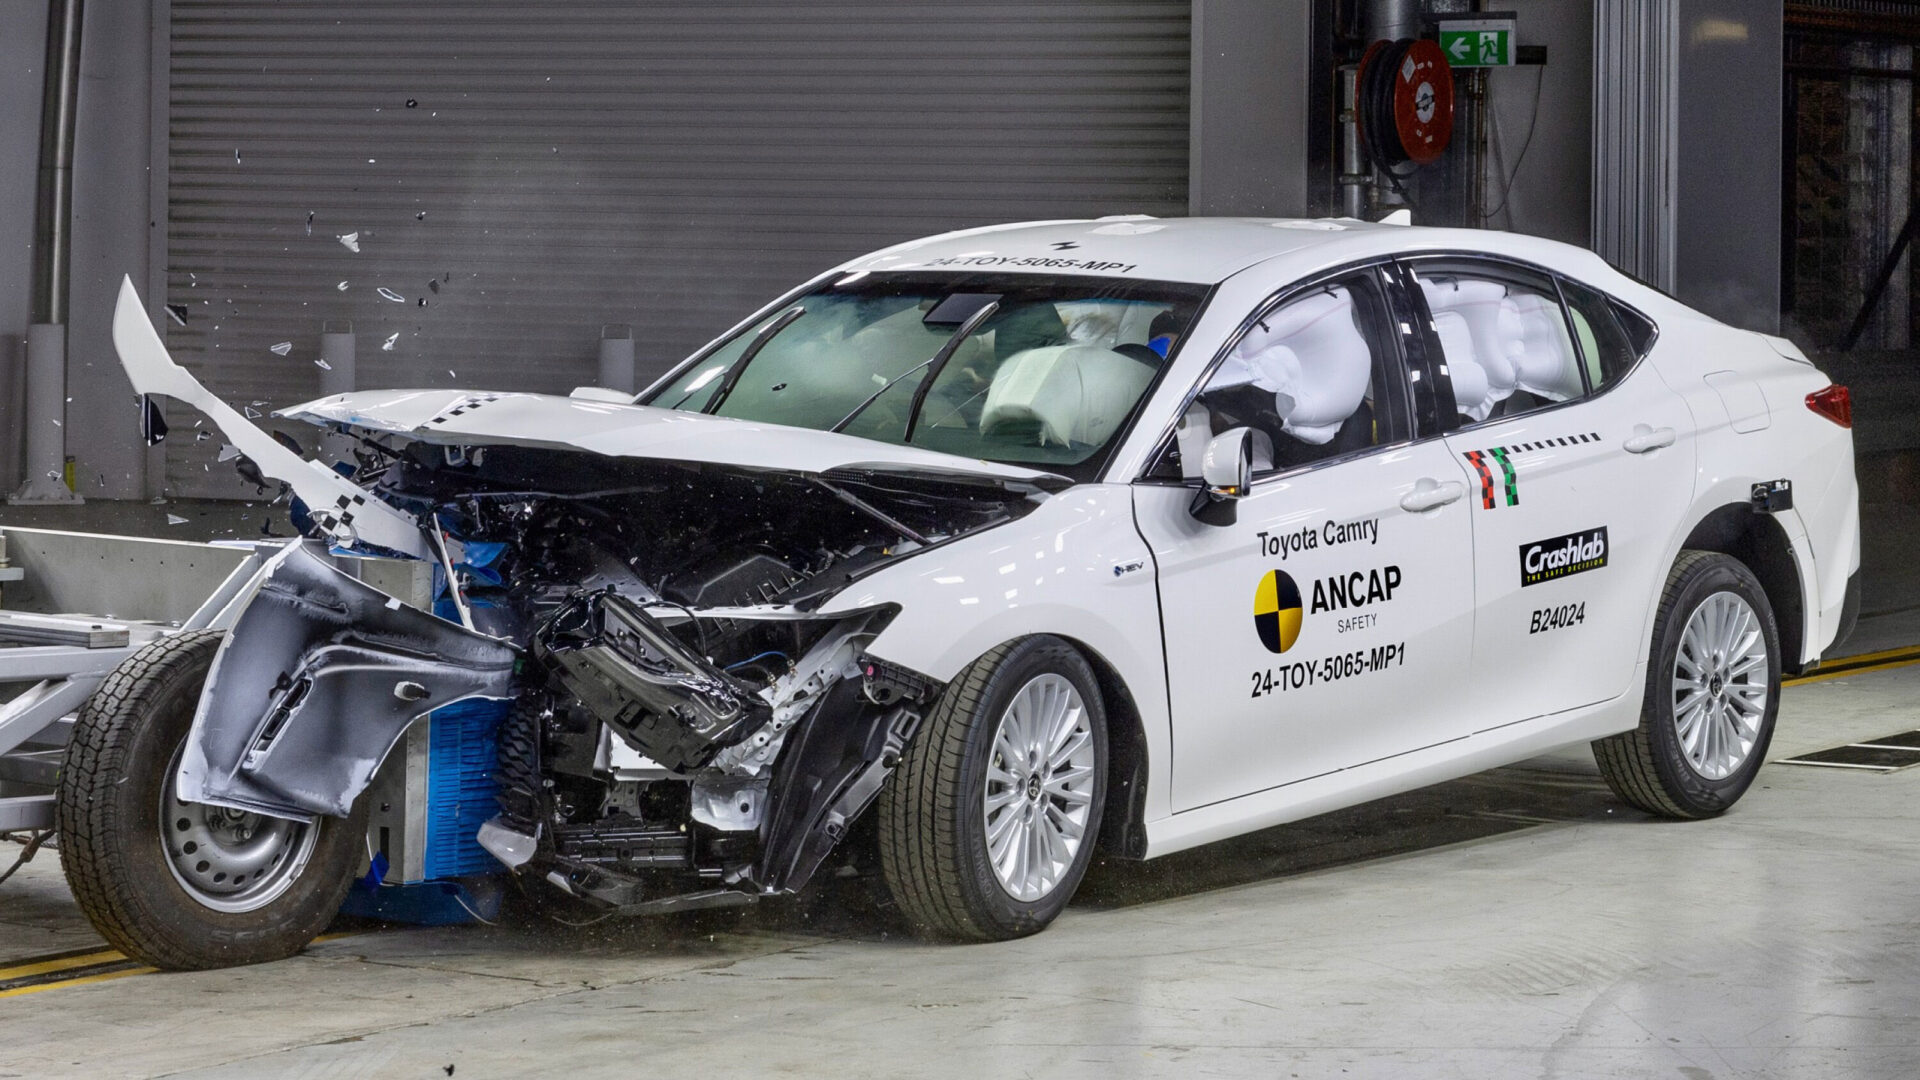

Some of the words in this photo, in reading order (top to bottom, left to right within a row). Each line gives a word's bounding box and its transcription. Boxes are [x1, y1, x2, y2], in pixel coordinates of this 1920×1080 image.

[924, 256, 1138, 273] 24-TOY-5065-MP1
[1256, 526, 1318, 560] Toyota
[1323, 518, 1379, 545] Camry
[1525, 532, 1605, 574] Crashlab
[1527, 573, 1541, 583] THE
[1545, 568, 1563, 578] SAFE
[1567, 558, 1604, 573] DECISION
[1311, 565, 1402, 615] ANCAP
[1337, 613, 1377, 633] SAFETY
[1529, 601, 1585, 634] B24024
[1251, 642, 1405, 698] 24-TOY-5065-MP1
